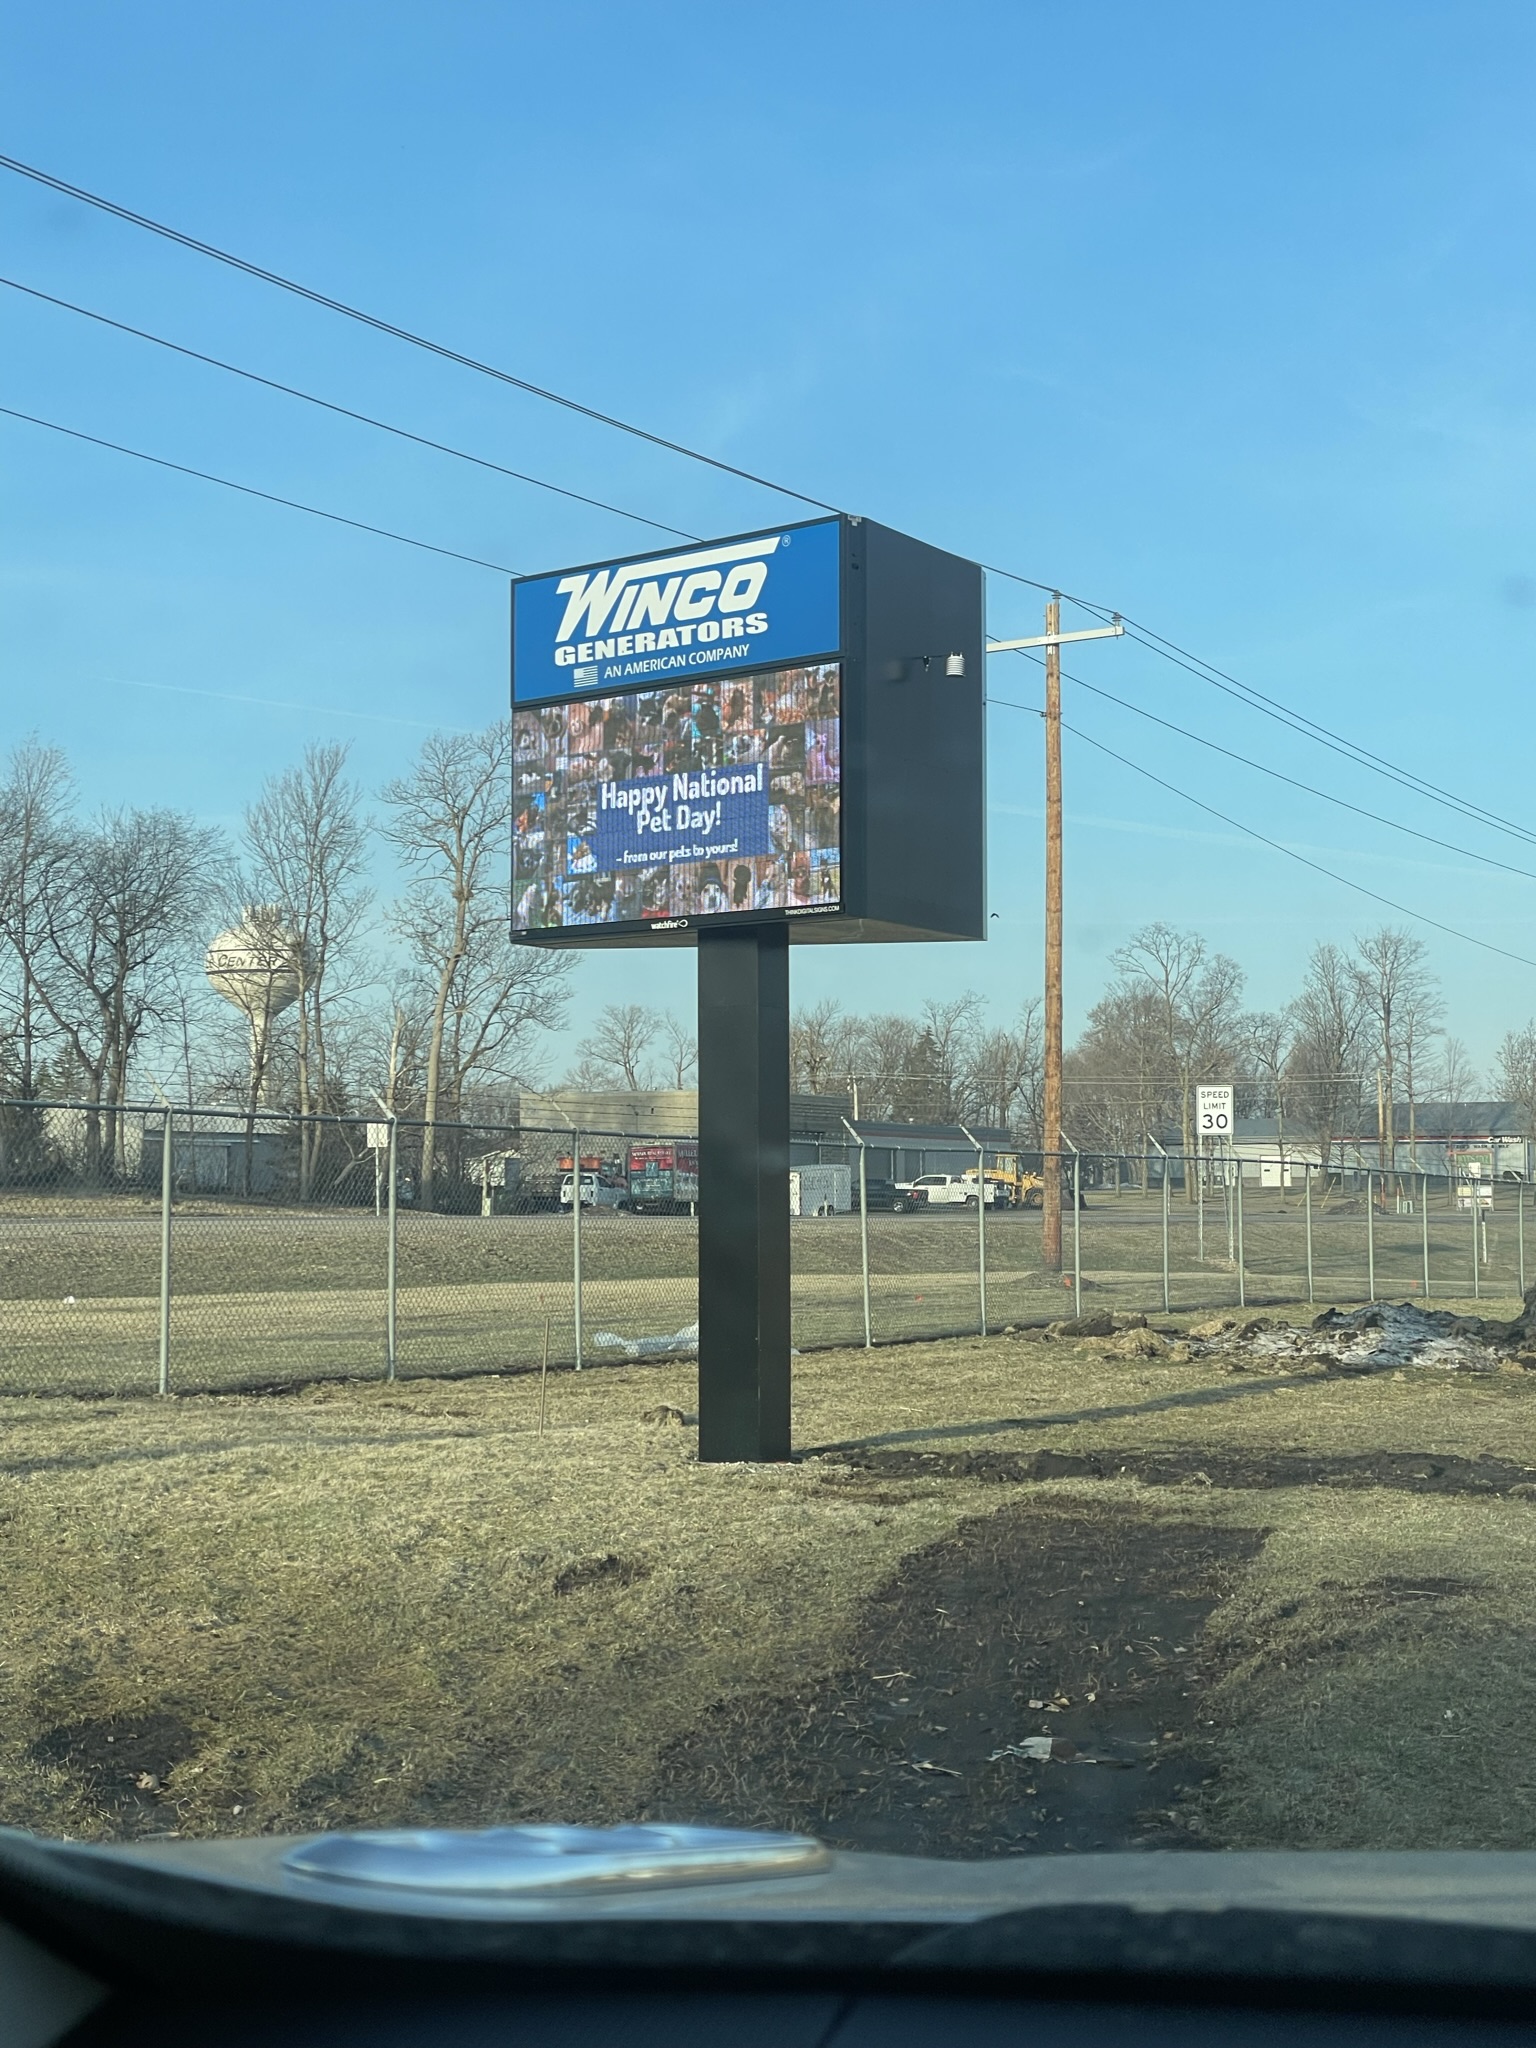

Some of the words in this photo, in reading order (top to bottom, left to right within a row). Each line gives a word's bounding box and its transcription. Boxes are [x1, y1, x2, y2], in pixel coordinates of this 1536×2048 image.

[555, 536, 781, 643] WINCO
[555, 613, 769, 666] GENERATORS
[604, 665, 622, 679] AN
[624, 655, 686, 676] AMERICAN
[688, 644, 750, 665] COMPANY
[601, 781, 668, 816] Happy
[672, 763, 763, 802] National
[637, 808, 672, 835] Pet
[676, 801, 721, 835] Day!
[624, 850, 648, 863] from
[649, 850, 667, 861] our
[669, 845, 691, 862] pets
[692, 844, 704, 857] to
[706, 838, 738, 858] yours!
[1202, 1113, 1228, 1129] 30
